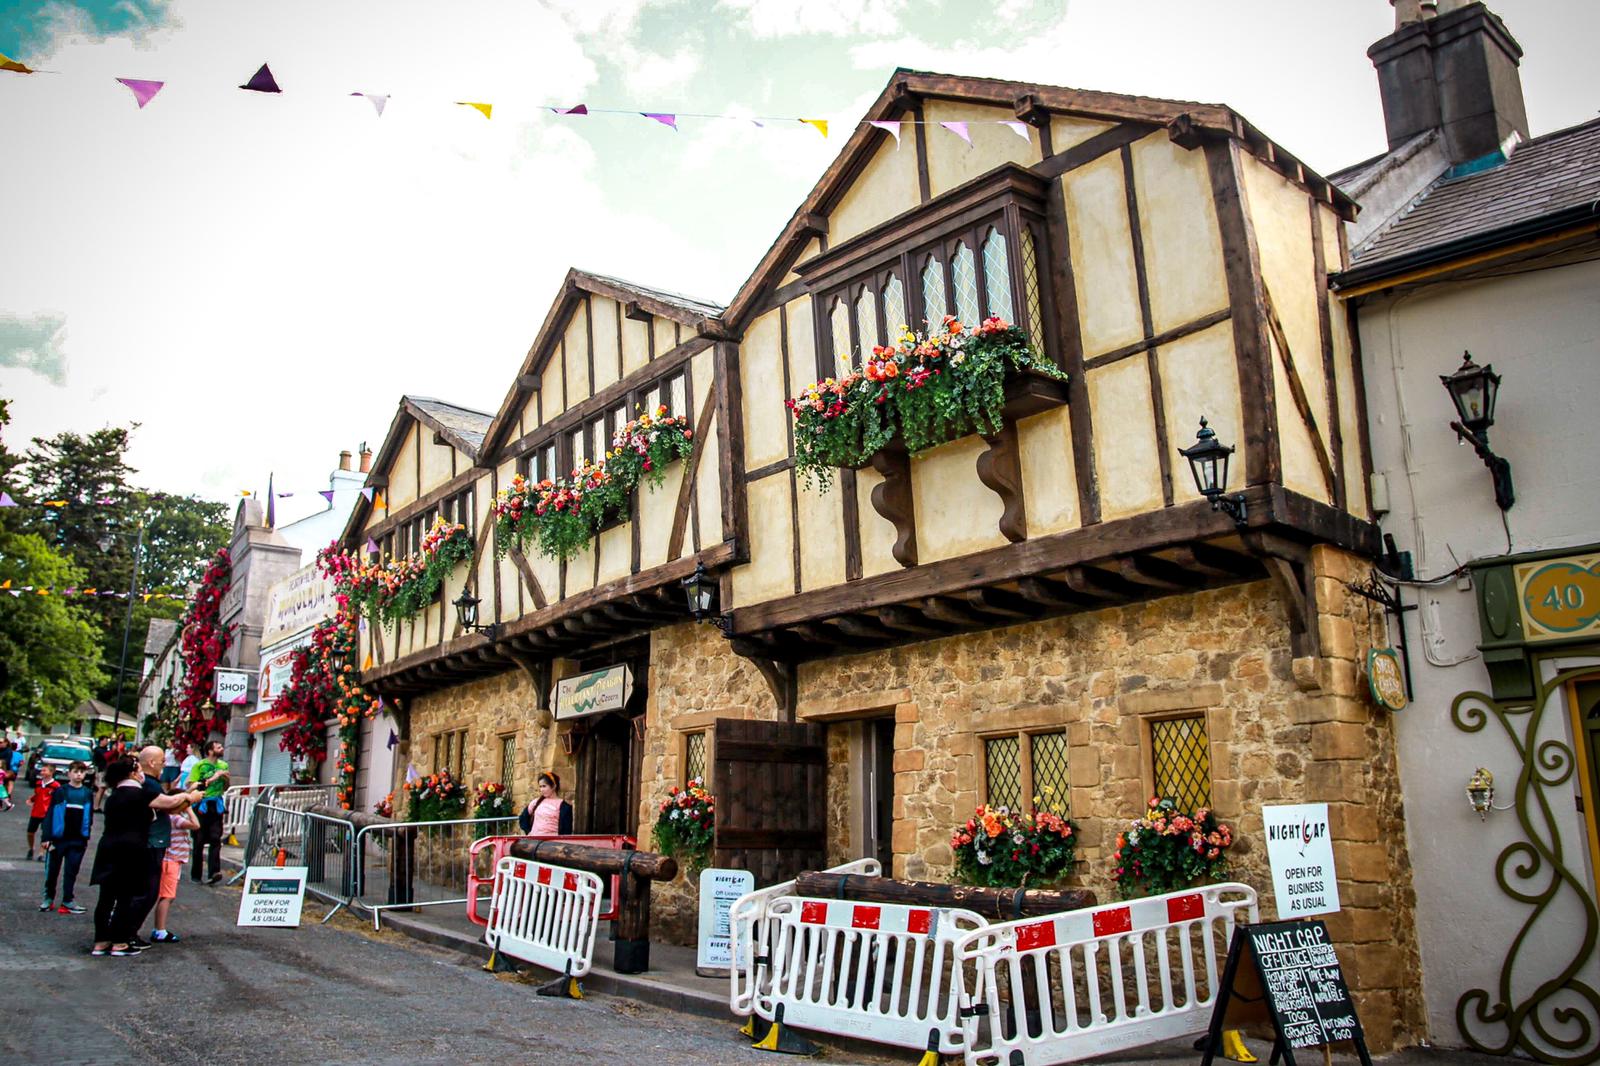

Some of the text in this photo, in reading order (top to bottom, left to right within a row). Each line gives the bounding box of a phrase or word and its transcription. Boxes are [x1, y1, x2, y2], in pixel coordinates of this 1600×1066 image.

[1542, 584, 1584, 611] 40
[220, 682, 246, 692] SHOP
[1285, 866, 1322, 880] OPEN FOR
[1288, 881, 1324, 895] BUSINESS
[1291, 896, 1326, 911] AS USUAL
[1253, 930, 1294, 953] NIGHT
[1296, 926, 1324, 950] CAP
[1261, 950, 1310, 968] OFF-LICENCE
[1284, 1024, 1320, 1038] GROWLERS
